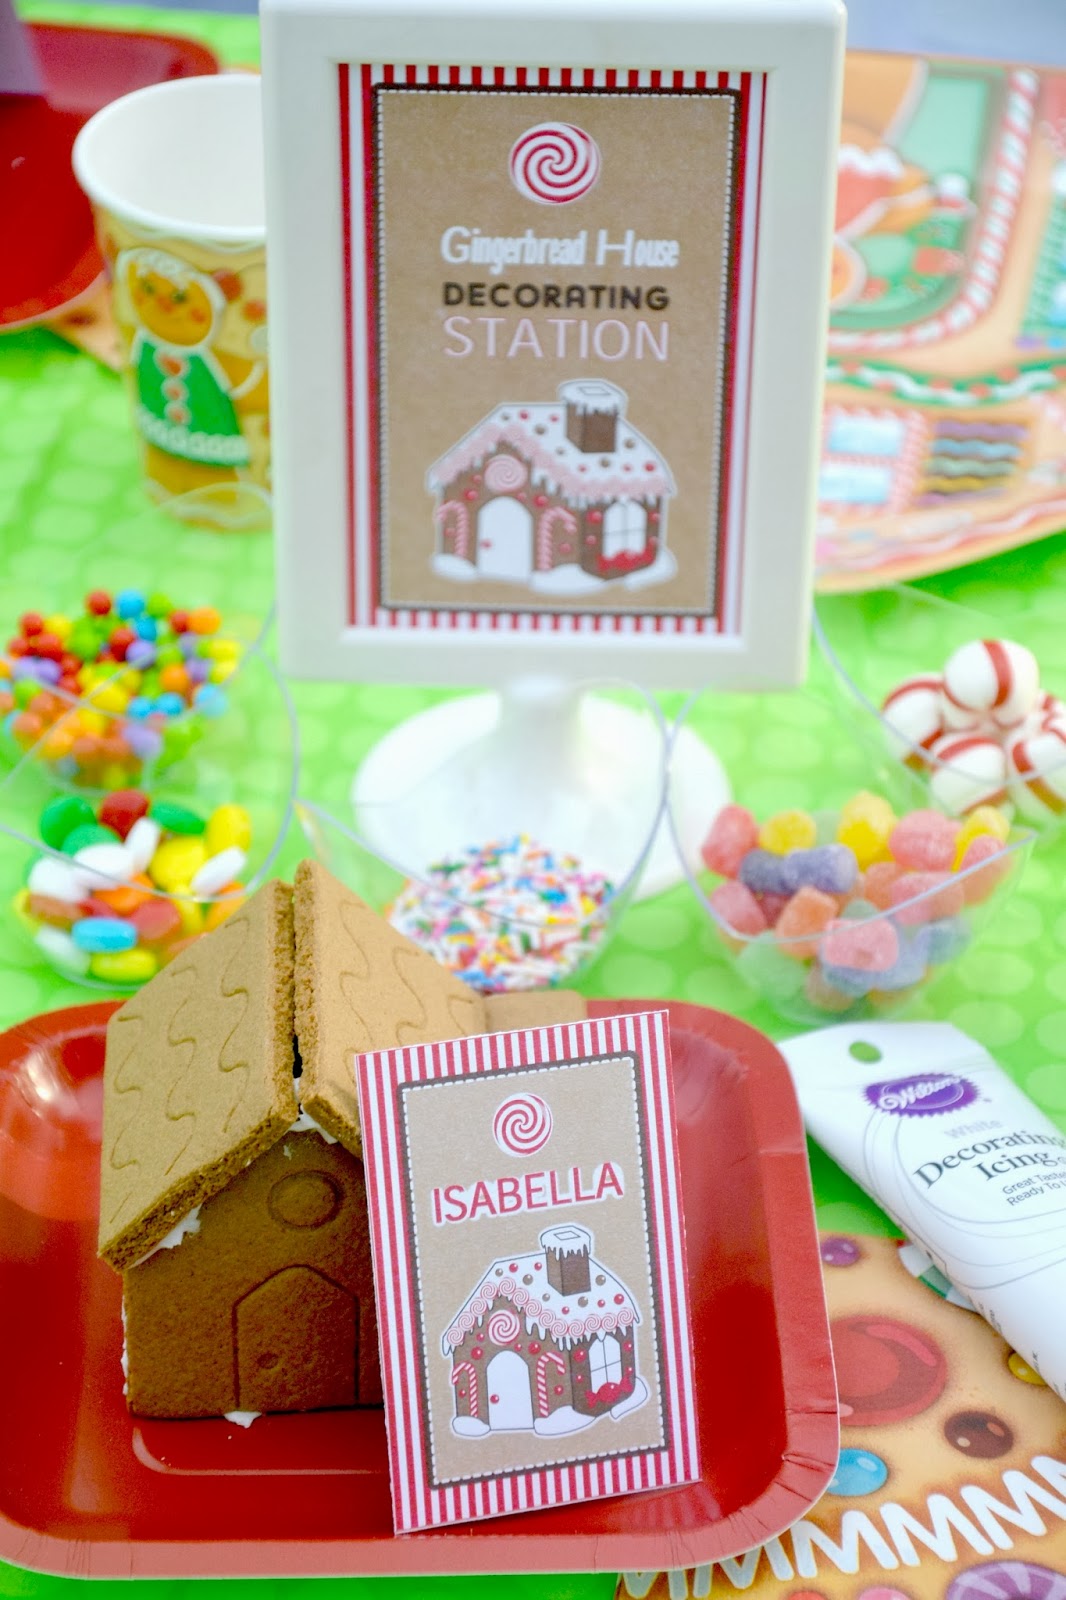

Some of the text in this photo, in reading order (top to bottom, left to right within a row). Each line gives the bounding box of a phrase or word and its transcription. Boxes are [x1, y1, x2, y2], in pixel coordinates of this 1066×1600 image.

[440, 225, 681, 276] Gingerbread House
[442, 281, 671, 311] DECORATING
[442, 315, 670, 361] STATION
[942, 1120, 1004, 1139] White
[972, 1152, 1058, 1181] Icing
[432, 1161, 625, 1225] ISABELLA
[1002, 1177, 1037, 1194] Great
[1006, 1186, 1045, 1206] Ready
